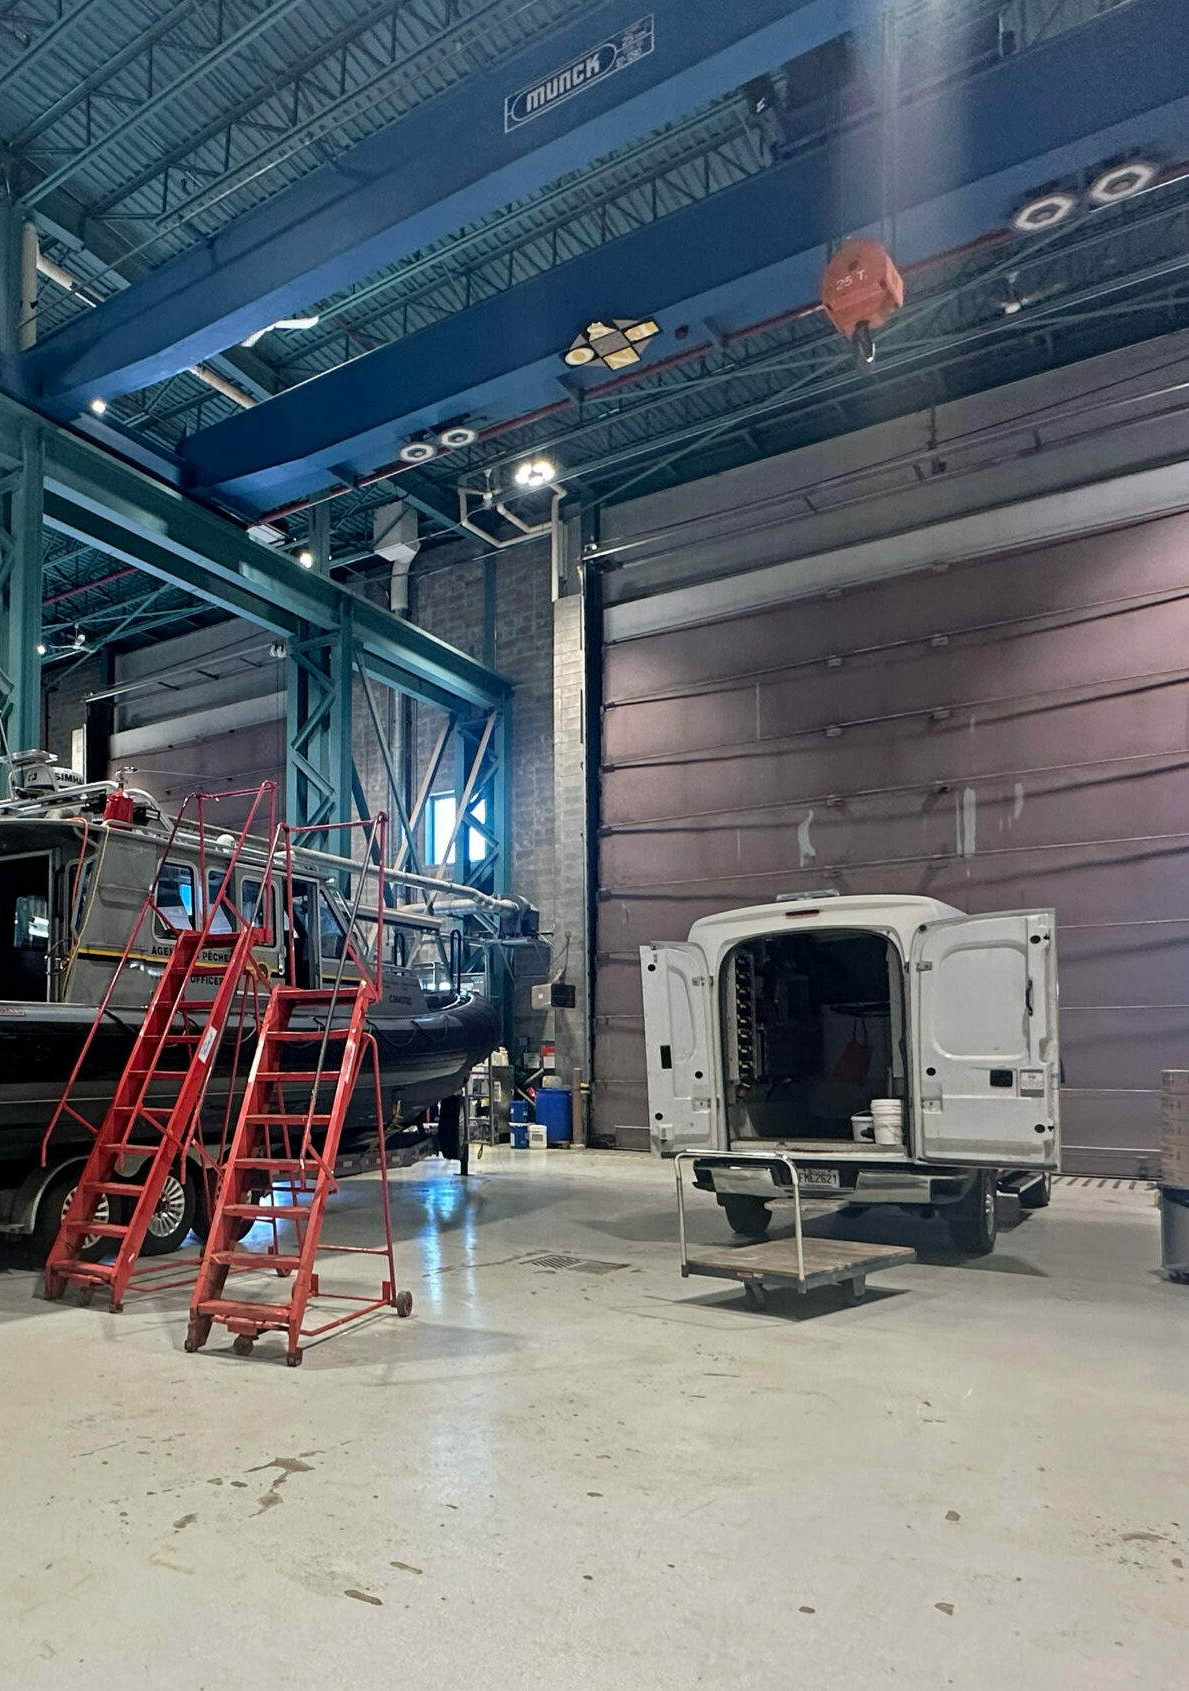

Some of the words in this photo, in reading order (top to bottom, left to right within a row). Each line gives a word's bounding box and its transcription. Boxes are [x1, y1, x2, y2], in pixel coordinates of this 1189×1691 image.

[526, 53, 600, 113] MUNCK
[835, 275, 853, 291] 25
[151, 945, 173, 956] AGE
[202, 950, 231, 962] PÊCHE
